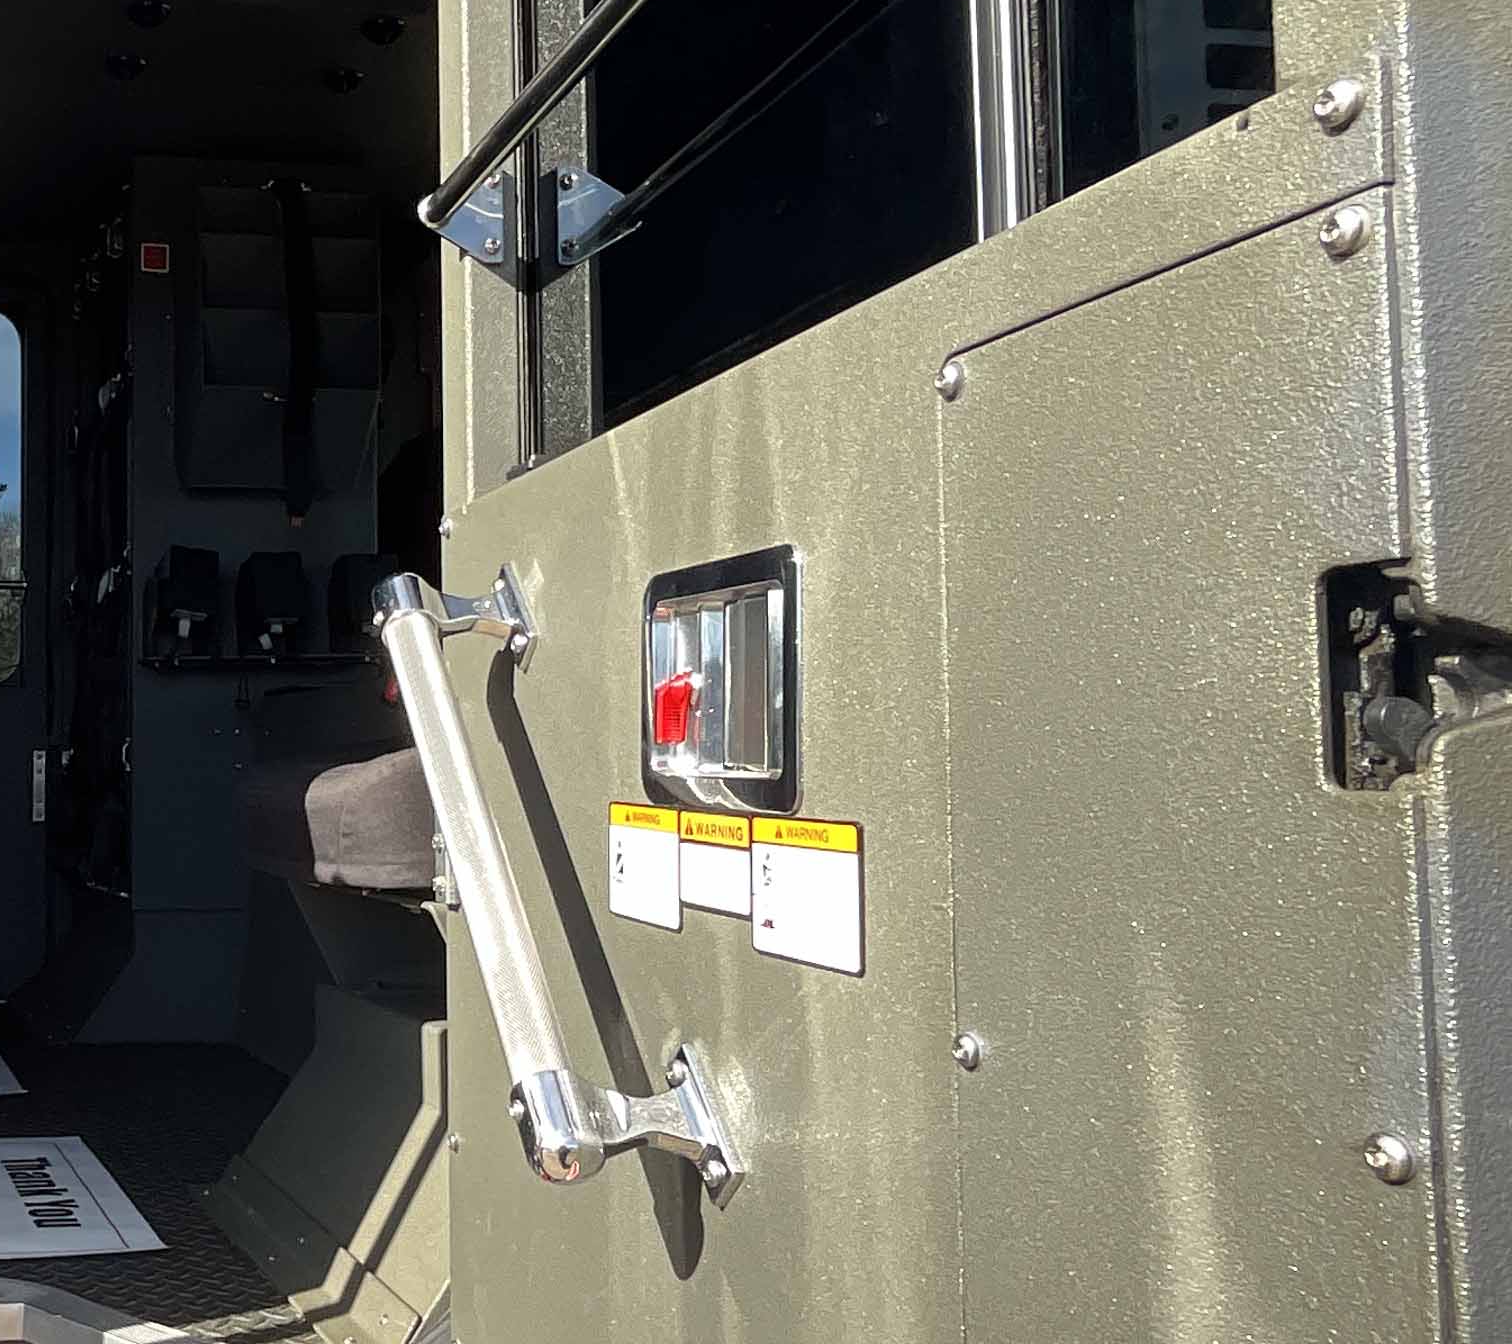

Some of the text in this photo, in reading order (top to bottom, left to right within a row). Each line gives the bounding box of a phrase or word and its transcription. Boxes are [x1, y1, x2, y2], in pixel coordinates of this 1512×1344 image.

[632, 810, 661, 826] WARNING
[695, 822, 744, 842] WARNING
[786, 825, 830, 844] WARNING
[0, 1157, 82, 1228] Thank You
